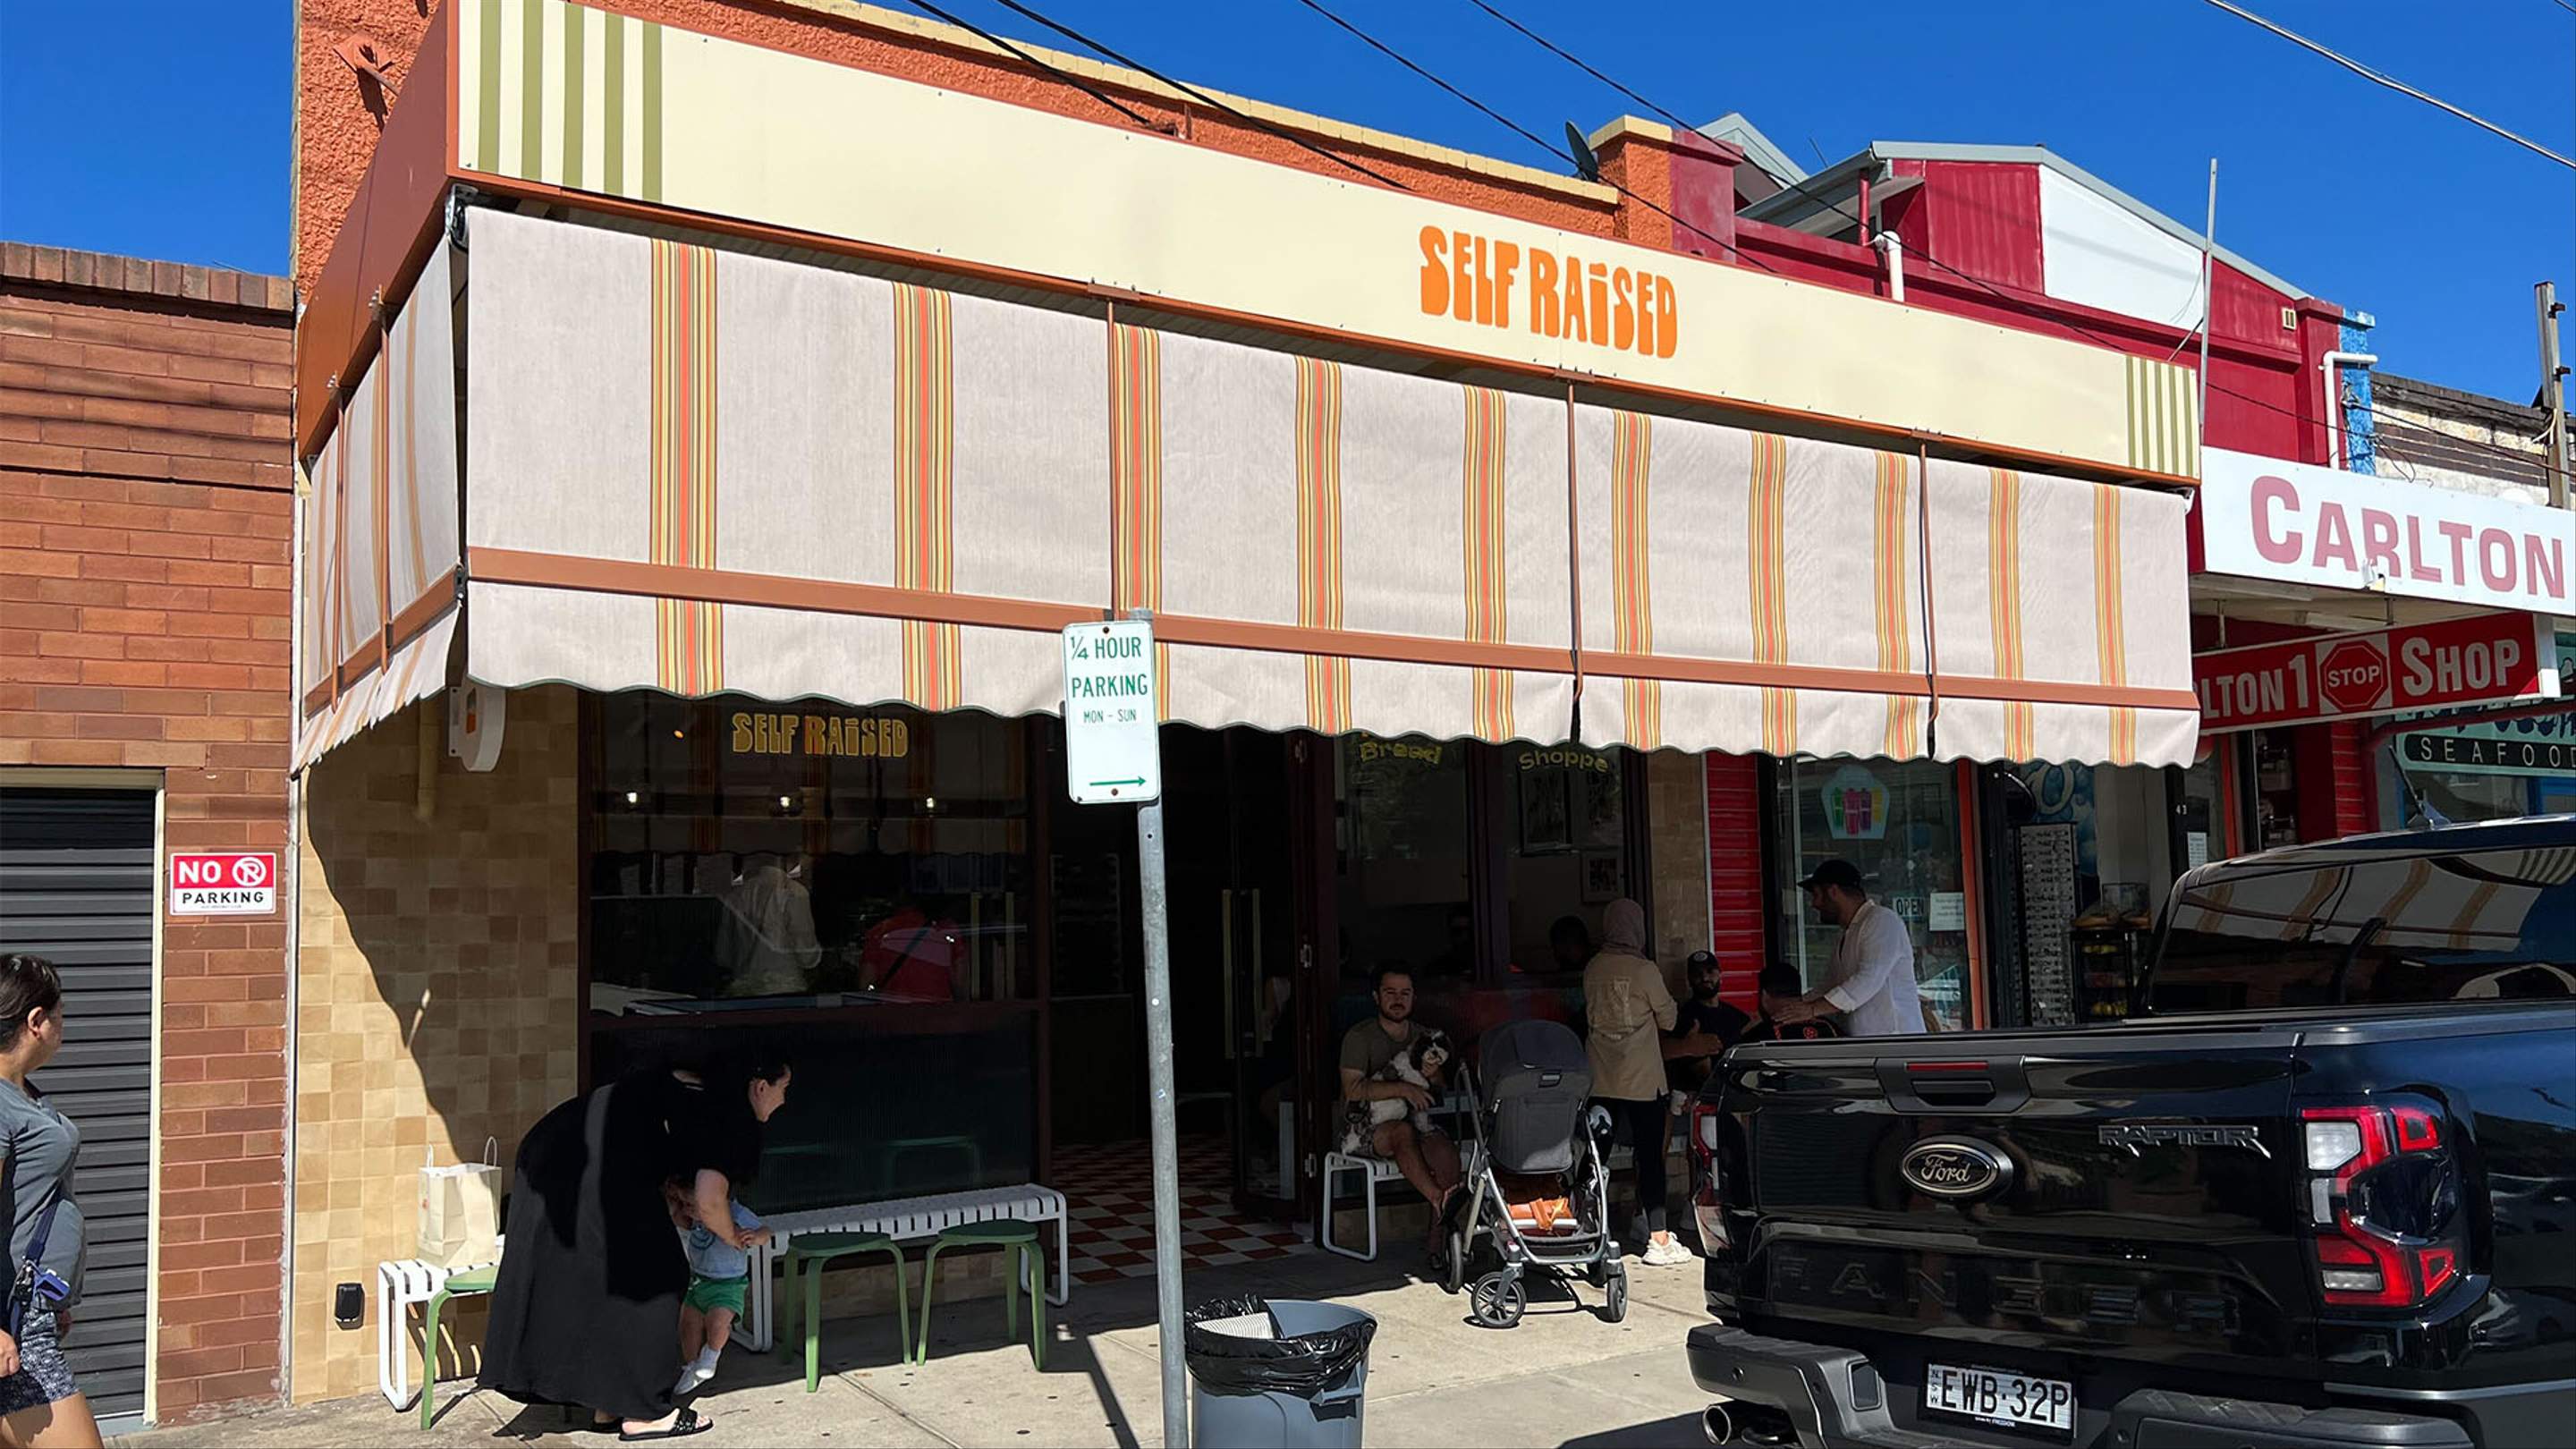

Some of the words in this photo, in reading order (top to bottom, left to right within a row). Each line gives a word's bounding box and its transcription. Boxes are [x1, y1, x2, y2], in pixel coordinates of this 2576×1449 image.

[1419, 225, 1520, 329] SELF
[2250, 475, 2566, 599] CARLTON
[1095, 636, 1141, 659] HOUR
[1072, 674, 1148, 698] PARKING
[2195, 667, 2285, 719] LTON
[2327, 665, 2380, 688] STOP
[2401, 637, 2521, 697] SHOP
[1083, 710, 1104, 723] MON
[1117, 708, 1137, 723] SUN
[732, 713, 800, 754] SELF
[1360, 741, 1443, 765] Bread
[1519, 750, 1610, 773] Shoppe
[179, 860, 222, 884] NO
[182, 892, 264, 904] PARKING
[1895, 898, 1925, 916] OPEN
[2098, 1125, 2271, 1159] RAPTOR
[1920, 1154, 1972, 1182] Ford
